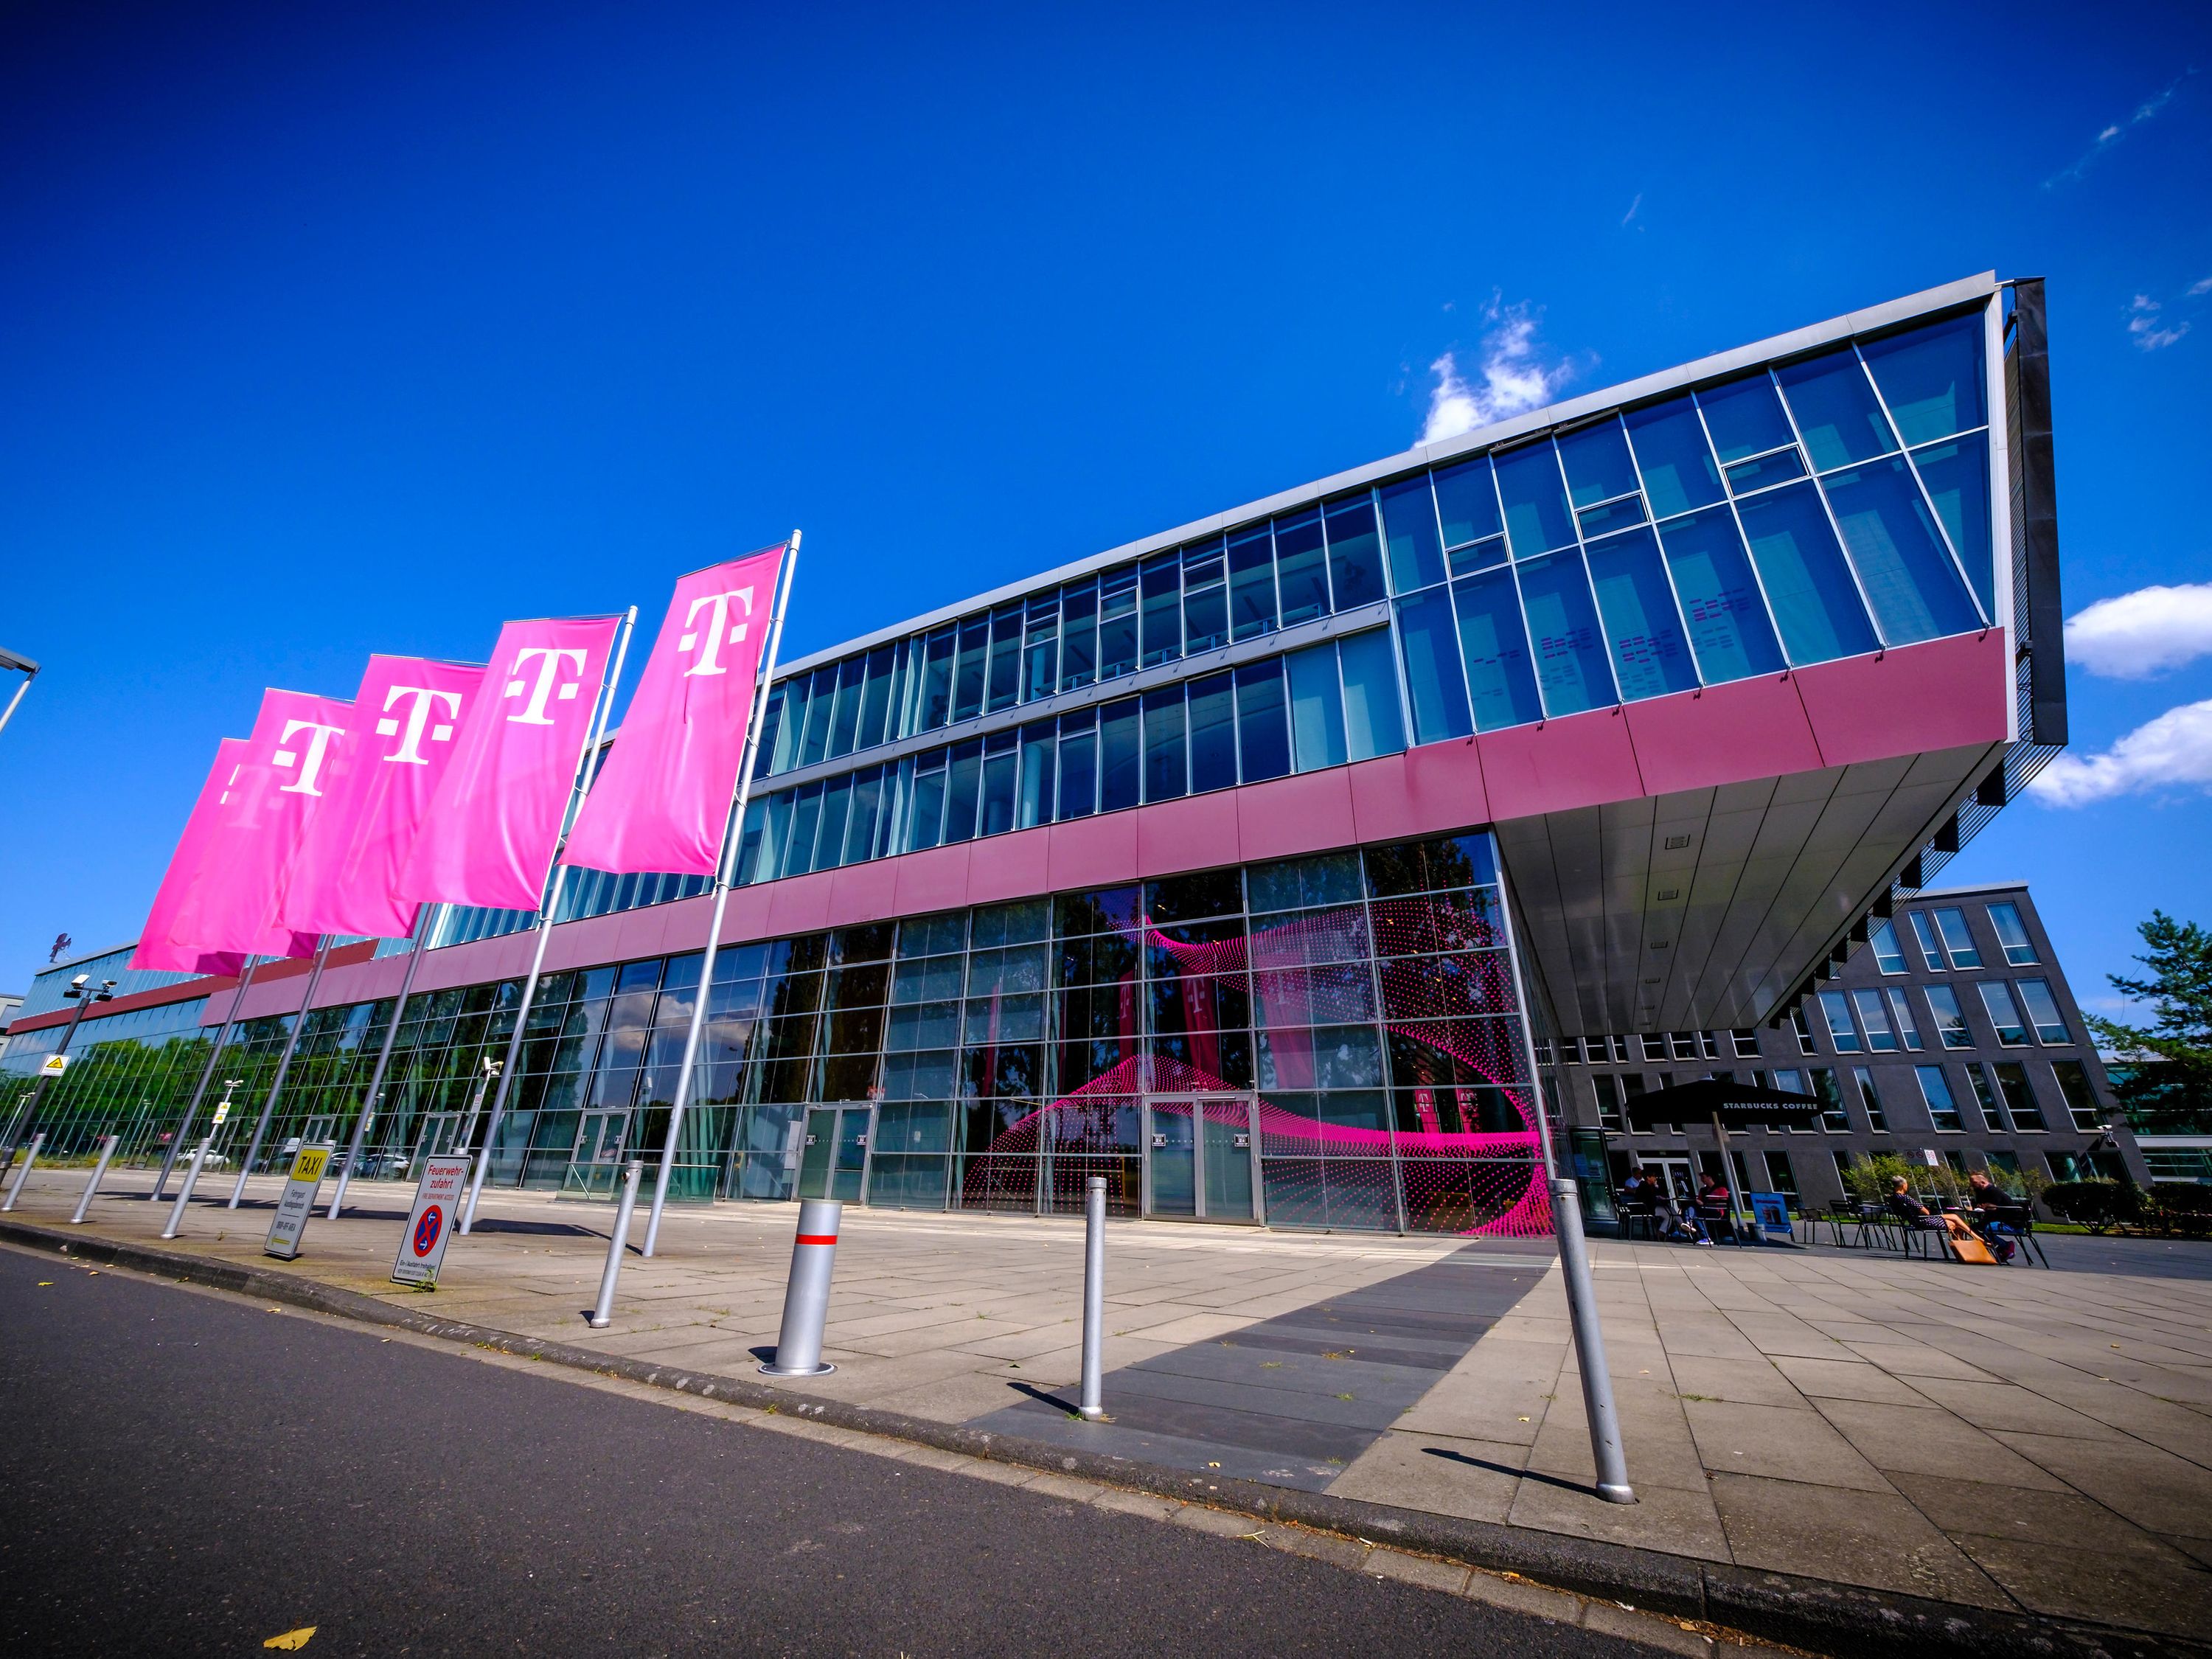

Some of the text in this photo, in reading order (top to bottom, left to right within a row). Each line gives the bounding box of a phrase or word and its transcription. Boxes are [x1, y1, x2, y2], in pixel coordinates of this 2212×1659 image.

[678, 585, 754, 677] T
[376, 685, 462, 765] T
[504, 648, 588, 725] T
[272, 719, 346, 796] T
[298, 1156, 322, 1175] TAXI
[428, 1165, 464, 1176] Feuerwehr-
[430, 1178, 453, 1189] zufahrt
